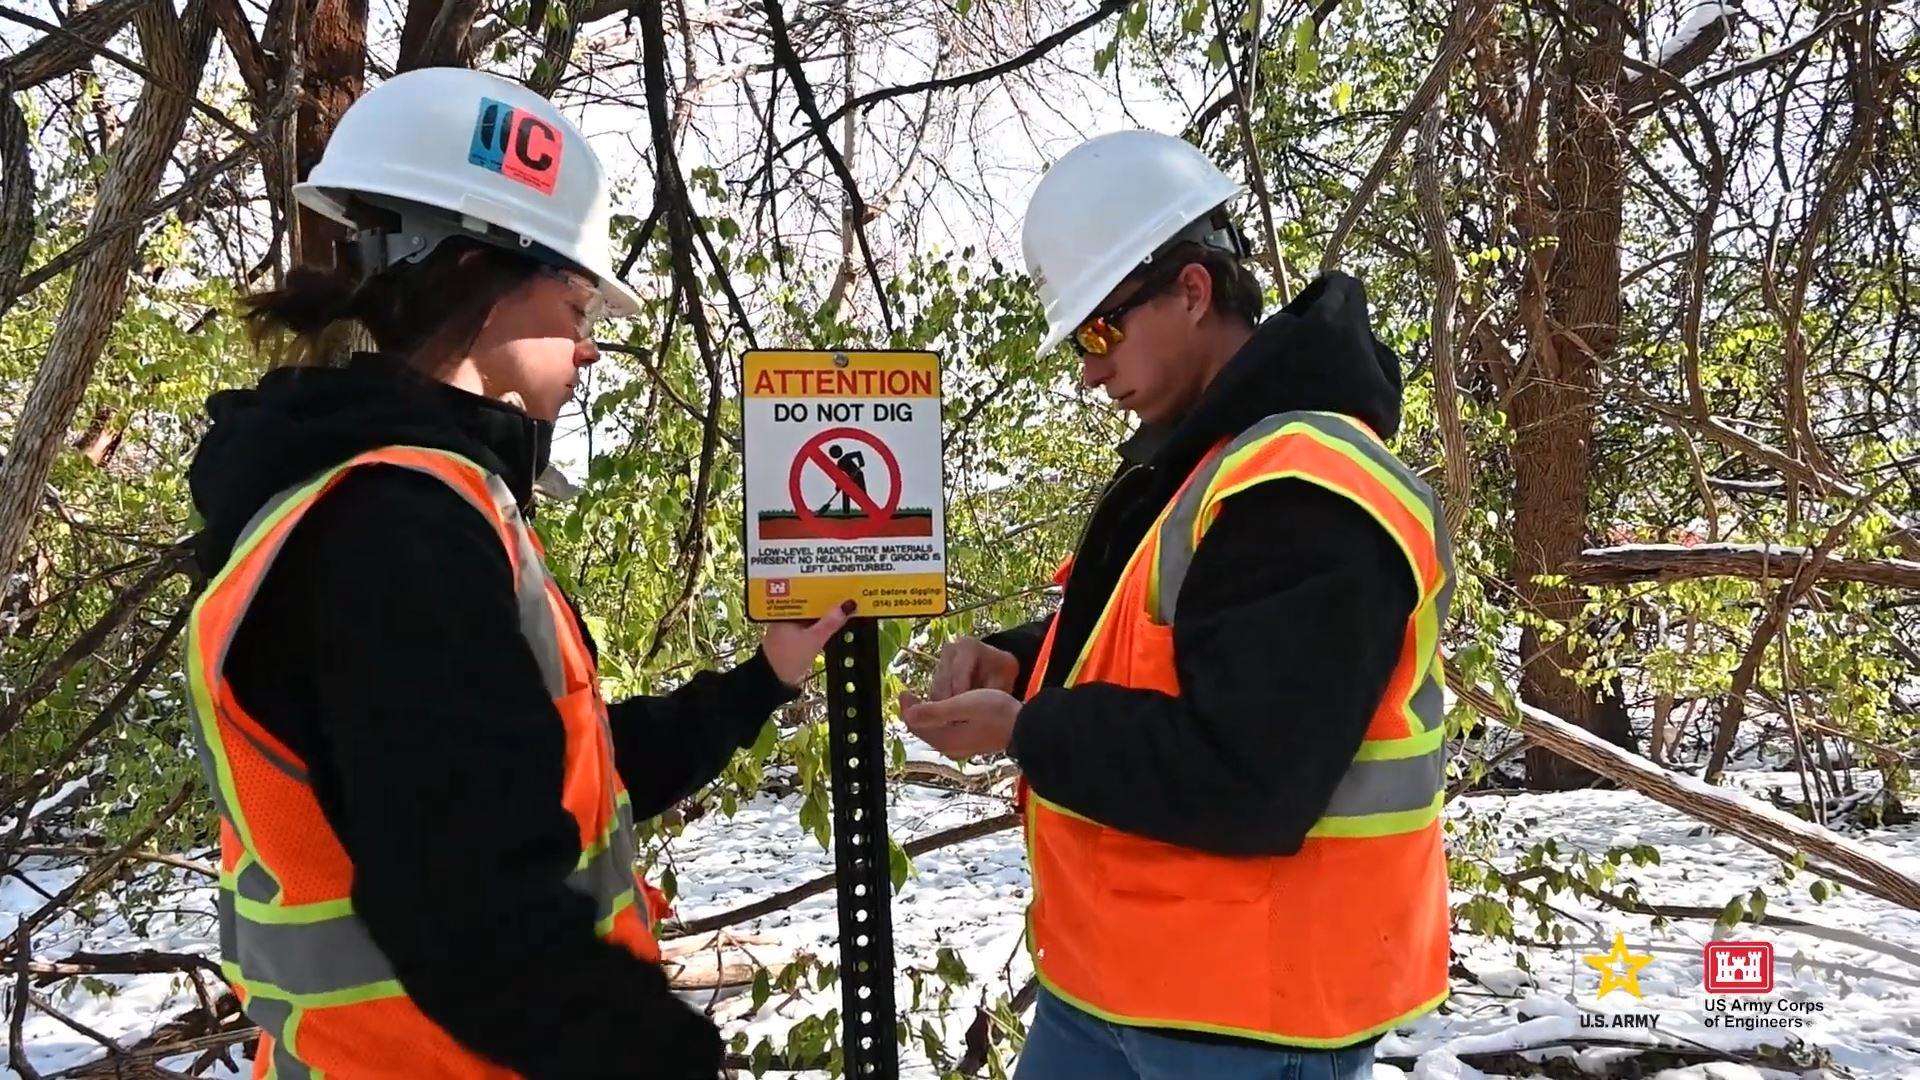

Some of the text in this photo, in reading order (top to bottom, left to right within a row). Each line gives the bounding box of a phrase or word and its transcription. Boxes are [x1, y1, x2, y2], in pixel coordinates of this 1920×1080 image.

[754, 369, 932, 395] ATTENTION
[774, 403, 913, 422] DO NOT DIG
[758, 544, 933, 556] LOW-LEVEL RADIOACTIVE MATERIALS
[798, 556, 813, 564] NO
[816, 555, 852, 563] HEALTH
[855, 554, 876, 562] RISK
[890, 553, 930, 562] GROUND
[933, 552, 941, 561] IS
[801, 563, 896, 573] LEFT UNDISTURBED.
[862, 588, 879, 596] Call
[881, 587, 907, 596] before
